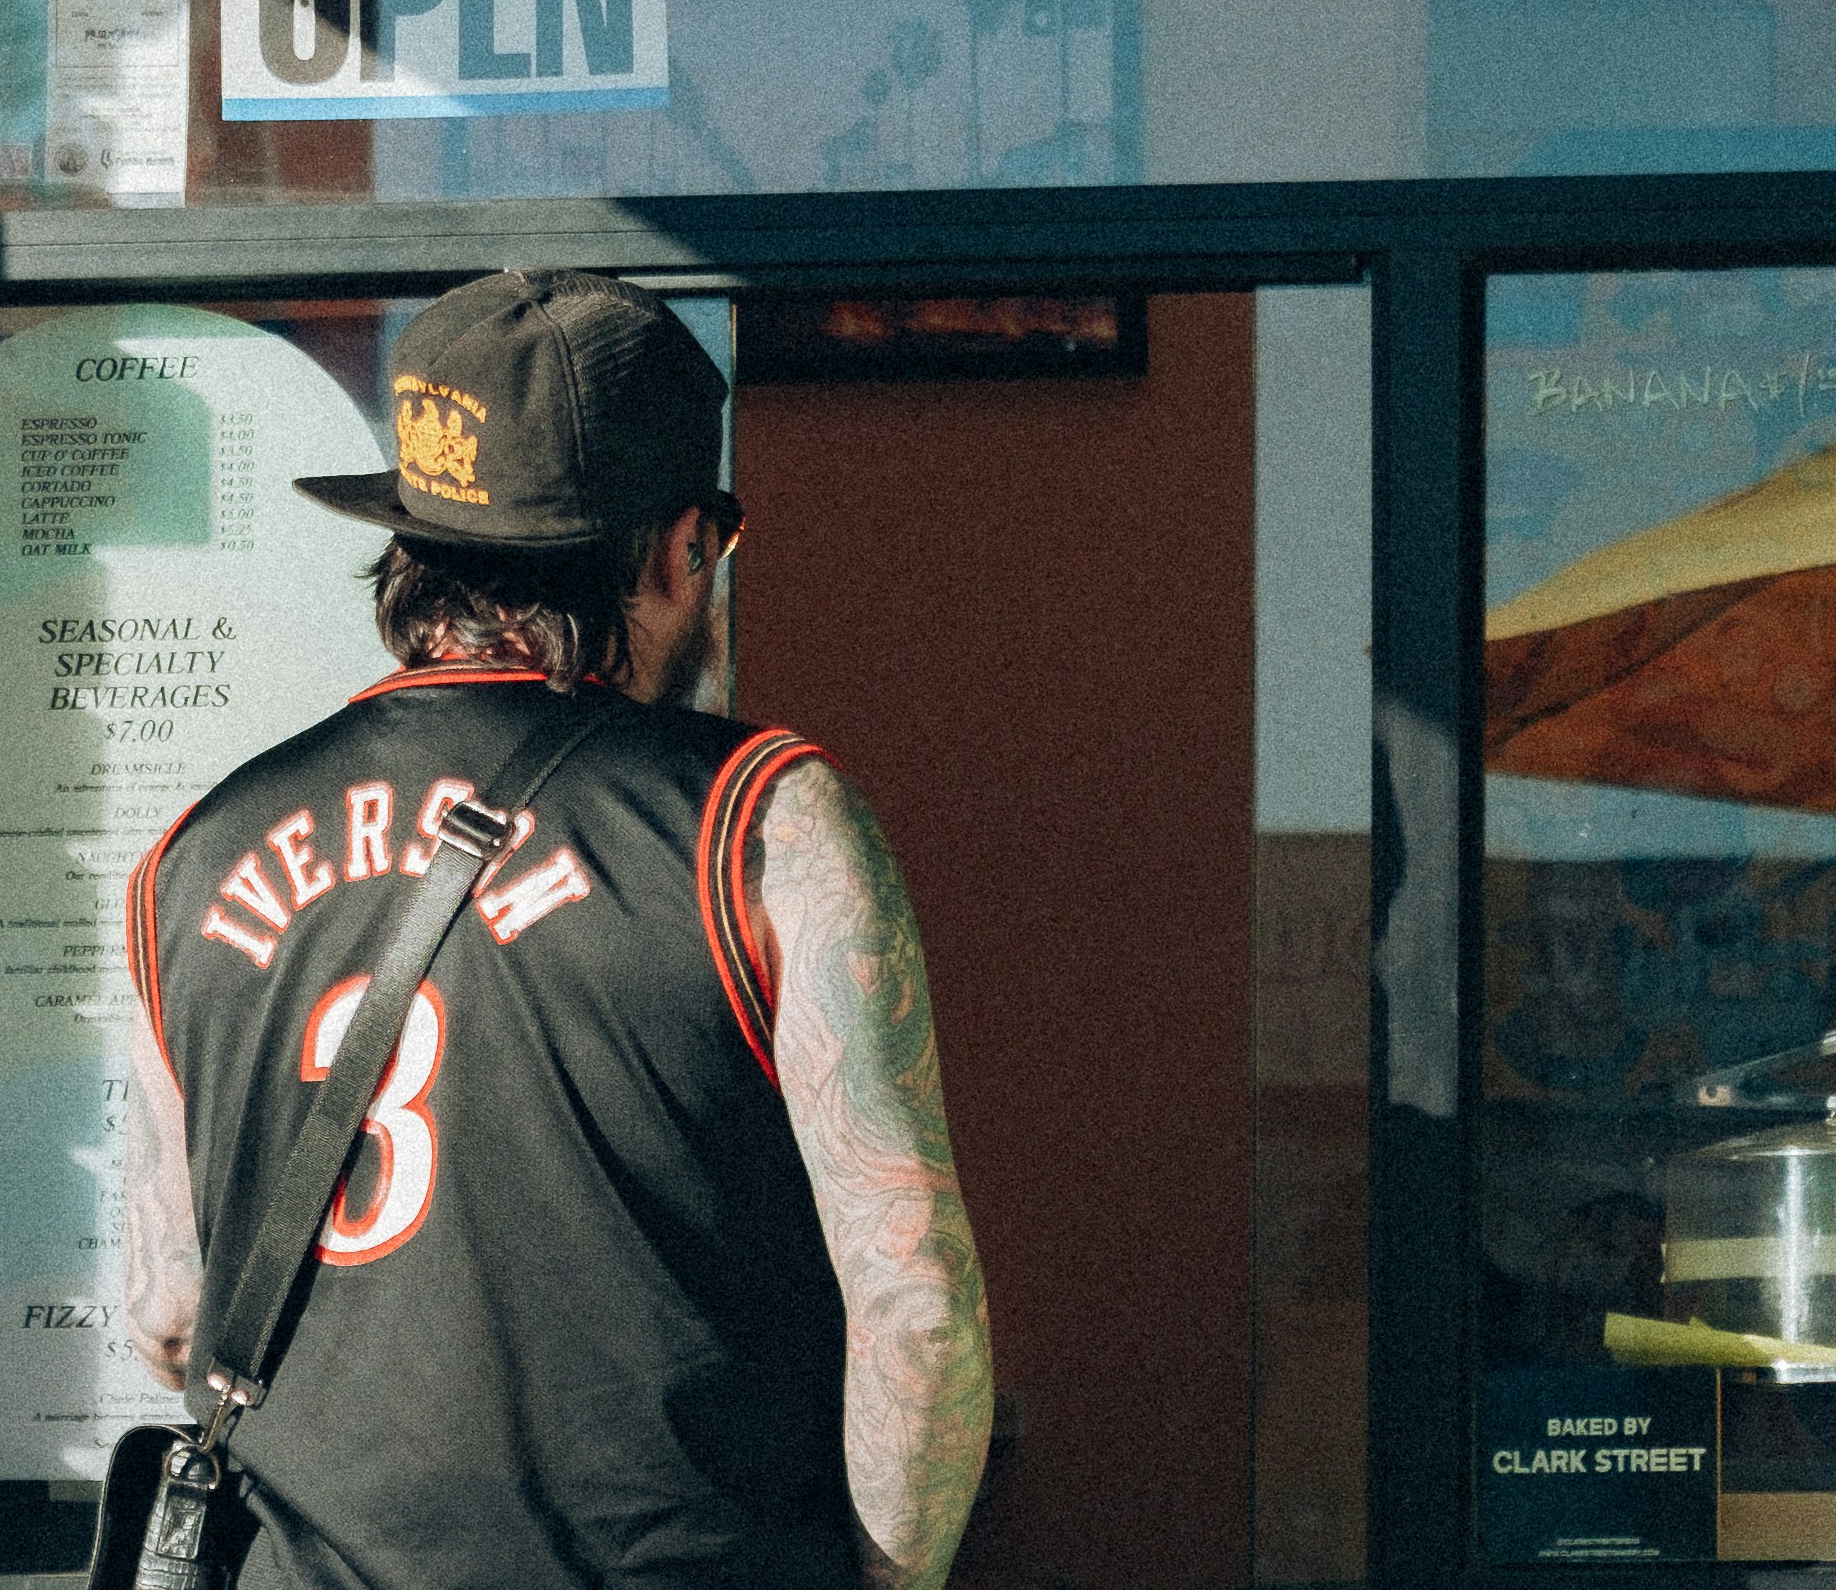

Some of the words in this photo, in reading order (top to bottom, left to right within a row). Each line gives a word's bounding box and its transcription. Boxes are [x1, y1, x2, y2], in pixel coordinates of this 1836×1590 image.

[75, 356, 200, 382] COFFEE
[21, 417, 98, 430] ESPRESSO
[21, 433, 98, 446] ESPRESSO
[102, 431, 148, 445] TONIC
[21, 450, 52, 461] CUP
[71, 448, 131, 460] COFFEE
[21, 465, 57, 478] ICED
[60, 464, 120, 476] COFFEE
[21, 481, 92, 493] CORTADO
[430, 480, 489, 505] POLICE
[21, 496, 115, 509] CAPPUCCINO
[21, 512, 70, 525] LATTE
[21, 528, 76, 540] MOCHA
[21, 544, 51, 556] OAT
[54, 543, 92, 555] MILK
[38, 617, 200, 643] SEASONAL
[212, 616, 236, 640] &
[54, 650, 225, 677] SPECIALTY
[50, 684, 231, 710] BEVERAGES
[104, 719, 174, 742] $7.00
[114, 807, 161, 819] DOLLY
[201, 776, 592, 969] IVERSN
[35, 995, 101, 1008] CARAMEL
[300, 973, 447, 1267] 3
[22, 1305, 118, 1329] FIZZY
[105, 1339, 139, 1362] $5.
[1547, 1418, 1618, 1437] BAKED
[1623, 1417, 1652, 1436] BY
[1492, 1449, 1588, 1475] CLARK
[1594, 1447, 1707, 1473] STREET
